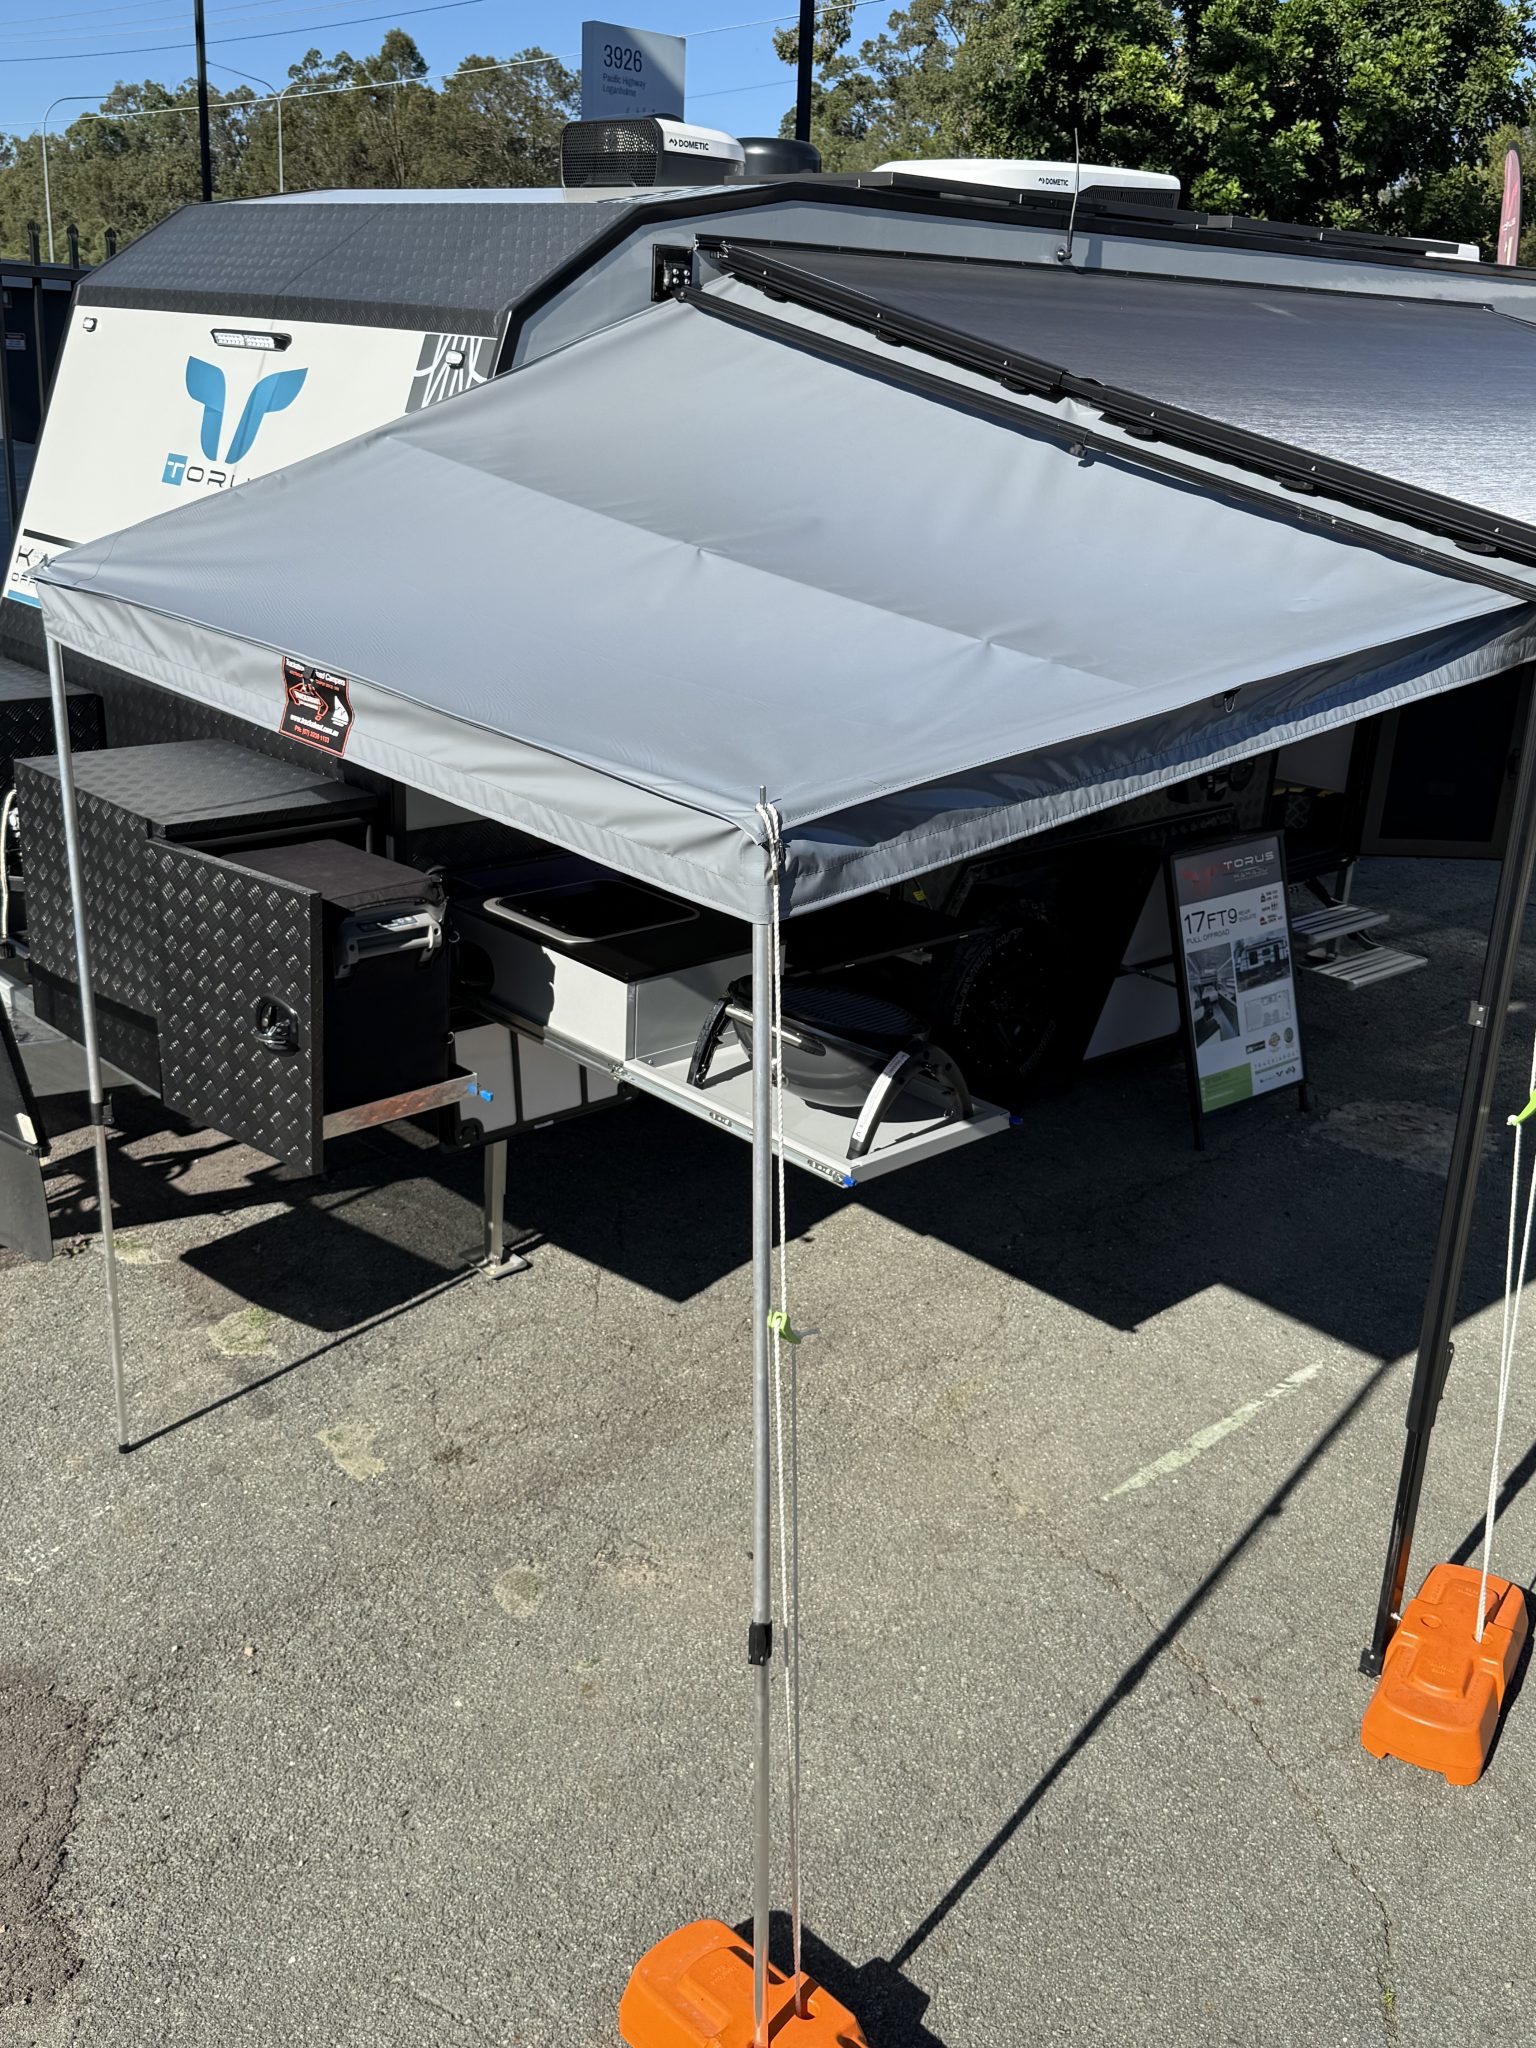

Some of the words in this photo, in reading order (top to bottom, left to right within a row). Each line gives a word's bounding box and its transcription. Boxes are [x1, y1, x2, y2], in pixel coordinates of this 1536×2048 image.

[603, 44, 642, 73] 3926
[678, 139, 709, 151] DOMETIC
[1045, 177, 1069, 187] DOMETIC
[1223, 851, 1275, 870] TORUS
[1184, 908, 1238, 934] 17FT9
[1186, 934, 1201, 945] FULL
[1202, 929, 1230, 941] OFFROAD
